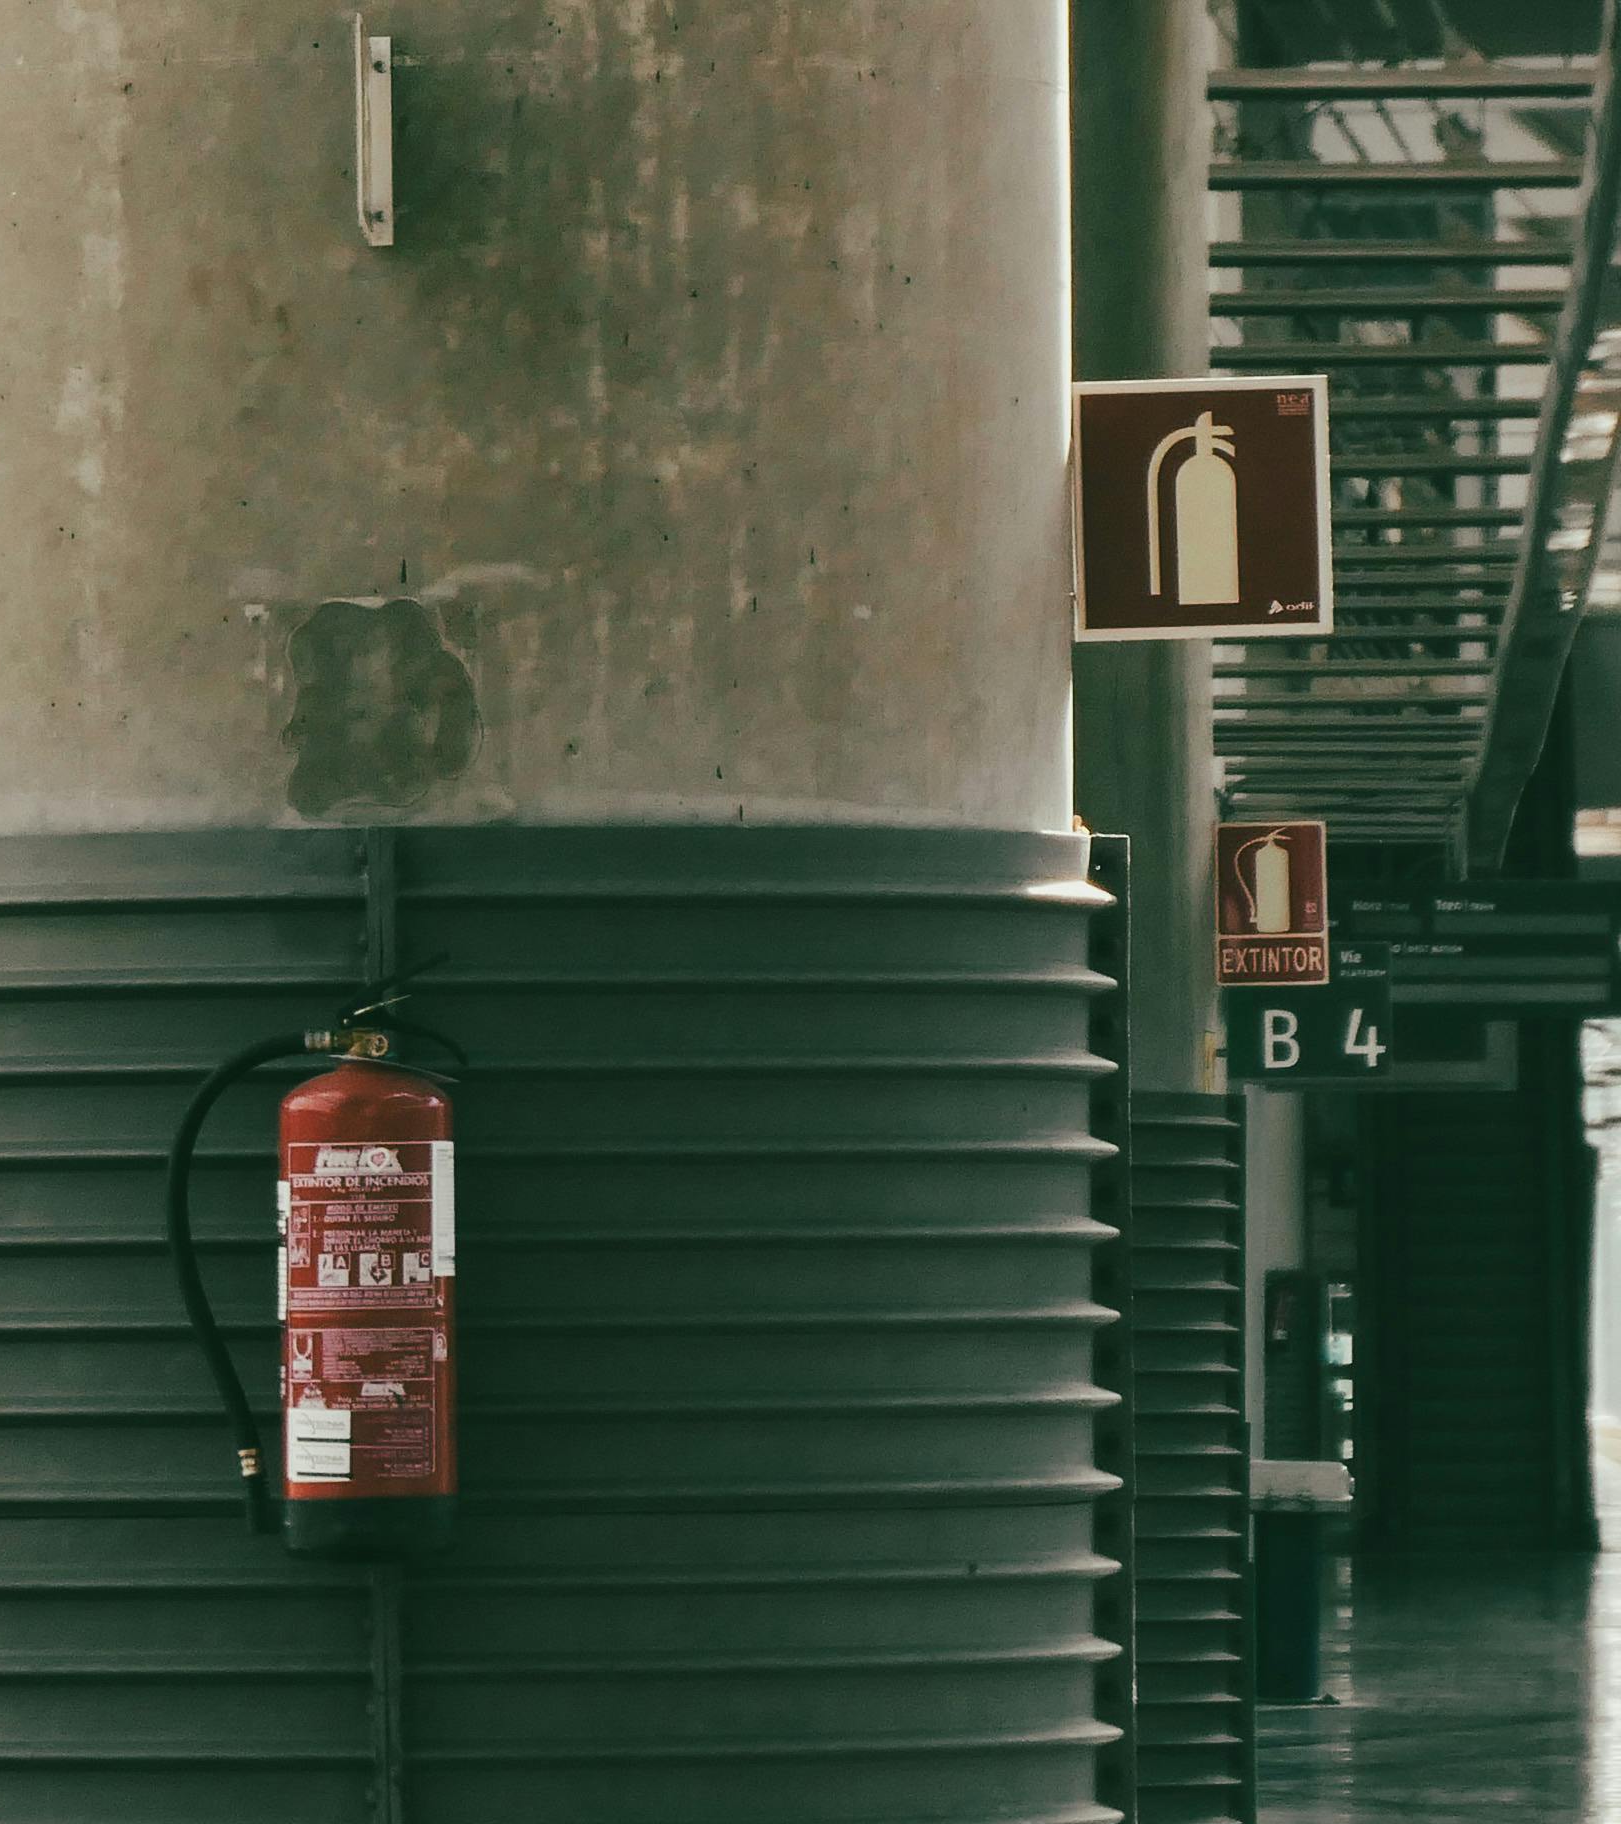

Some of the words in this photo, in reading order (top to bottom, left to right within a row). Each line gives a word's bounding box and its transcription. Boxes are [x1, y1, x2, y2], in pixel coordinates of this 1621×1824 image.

[1222, 946, 1323, 974] EXTINTOR
[1264, 1009, 1300, 1069] B
[1345, 1008, 1387, 1068] 4
[292, 1176, 342, 1189] EXTINTOR
[345, 1176, 361, 1188] DE
[364, 1175, 429, 1187] INCENDIOS
[335, 1256, 347, 1268] A
[380, 1254, 391, 1267] B
[421, 1252, 430, 1266] C
